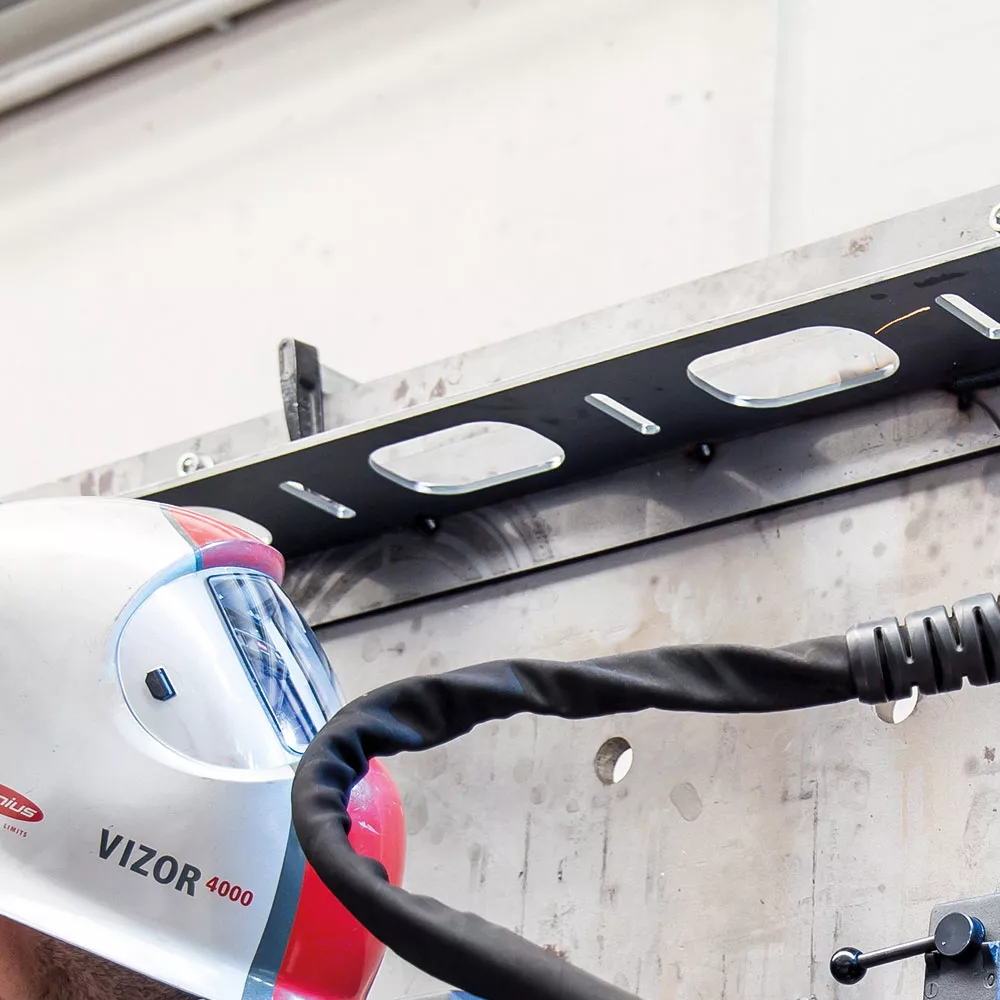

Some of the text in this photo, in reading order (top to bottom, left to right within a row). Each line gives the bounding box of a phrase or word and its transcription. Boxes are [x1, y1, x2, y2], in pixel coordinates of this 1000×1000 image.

[3, 823, 28, 838] LIMITS
[99, 828, 254, 907] VIZOR 4000
